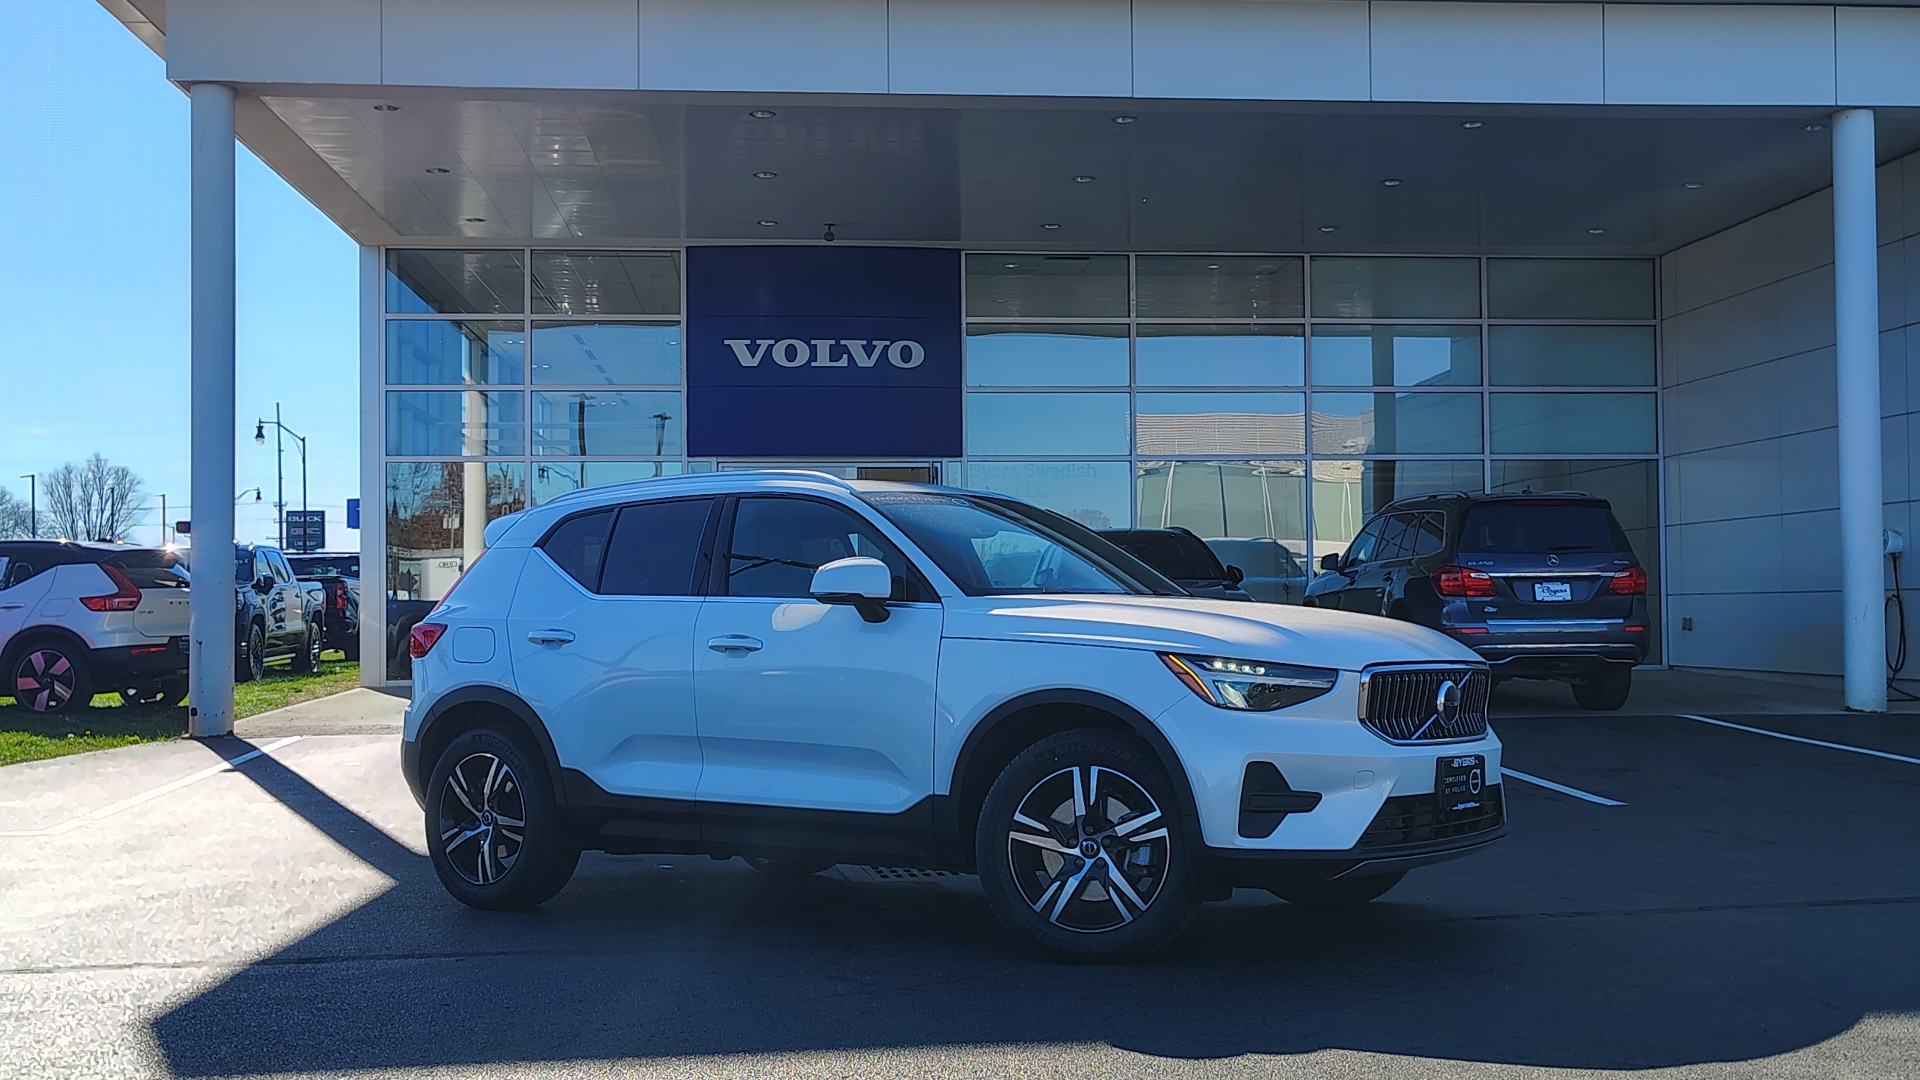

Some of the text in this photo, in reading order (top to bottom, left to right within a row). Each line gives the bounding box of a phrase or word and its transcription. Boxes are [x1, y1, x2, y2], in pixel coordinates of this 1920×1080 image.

[723, 338, 925, 369] VOLVO
[969, 463, 1097, 481] Byers Swedish
[1015, 483, 1049, 498] LLC
[1453, 756, 1475, 768] BYERS
